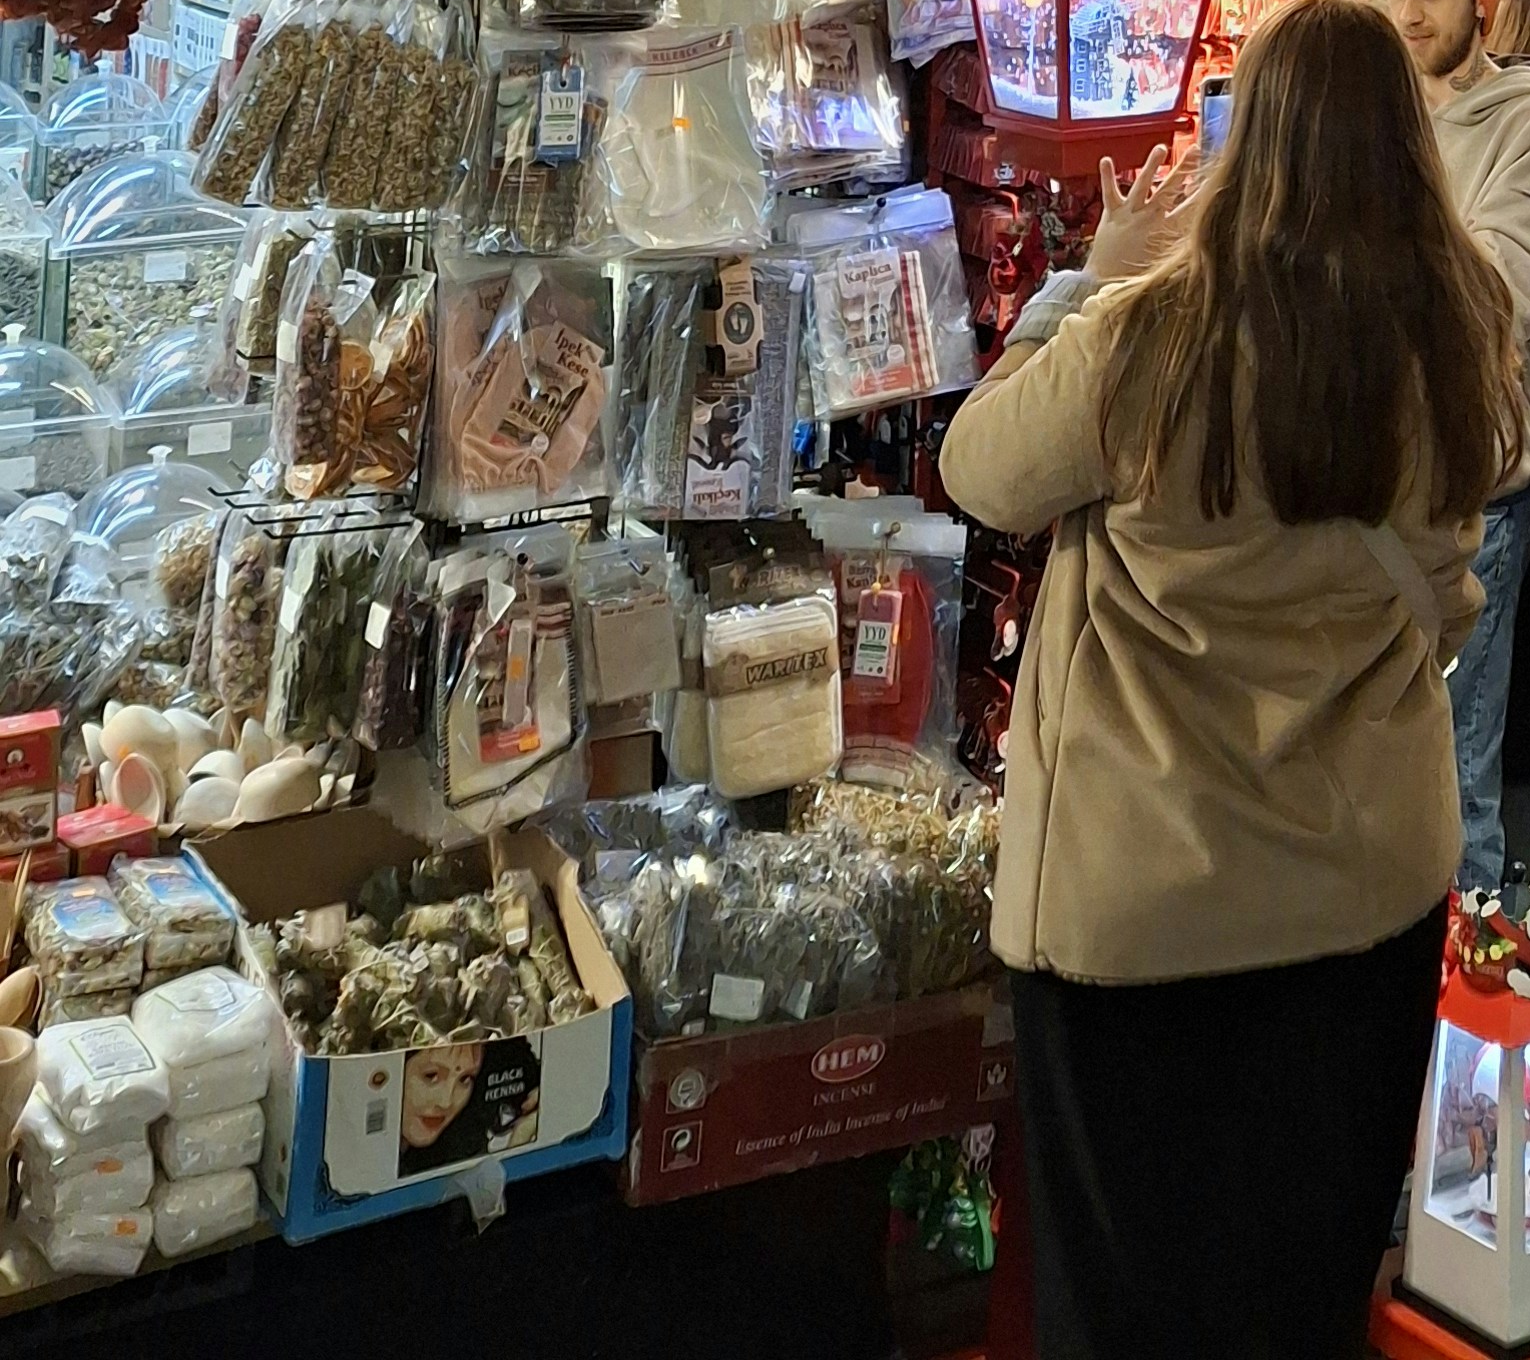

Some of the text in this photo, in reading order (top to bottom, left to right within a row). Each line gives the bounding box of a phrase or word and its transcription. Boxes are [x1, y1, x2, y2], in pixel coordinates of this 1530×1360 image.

[556, 351, 589, 379] Kese
[817, 1043, 879, 1073] HEM
[487, 1066, 524, 1087] BLACK
[484, 1081, 526, 1102] HENNA
[813, 1082, 877, 1107] INCENSE
[735, 1097, 947, 1156] Essence of India Incense of India
